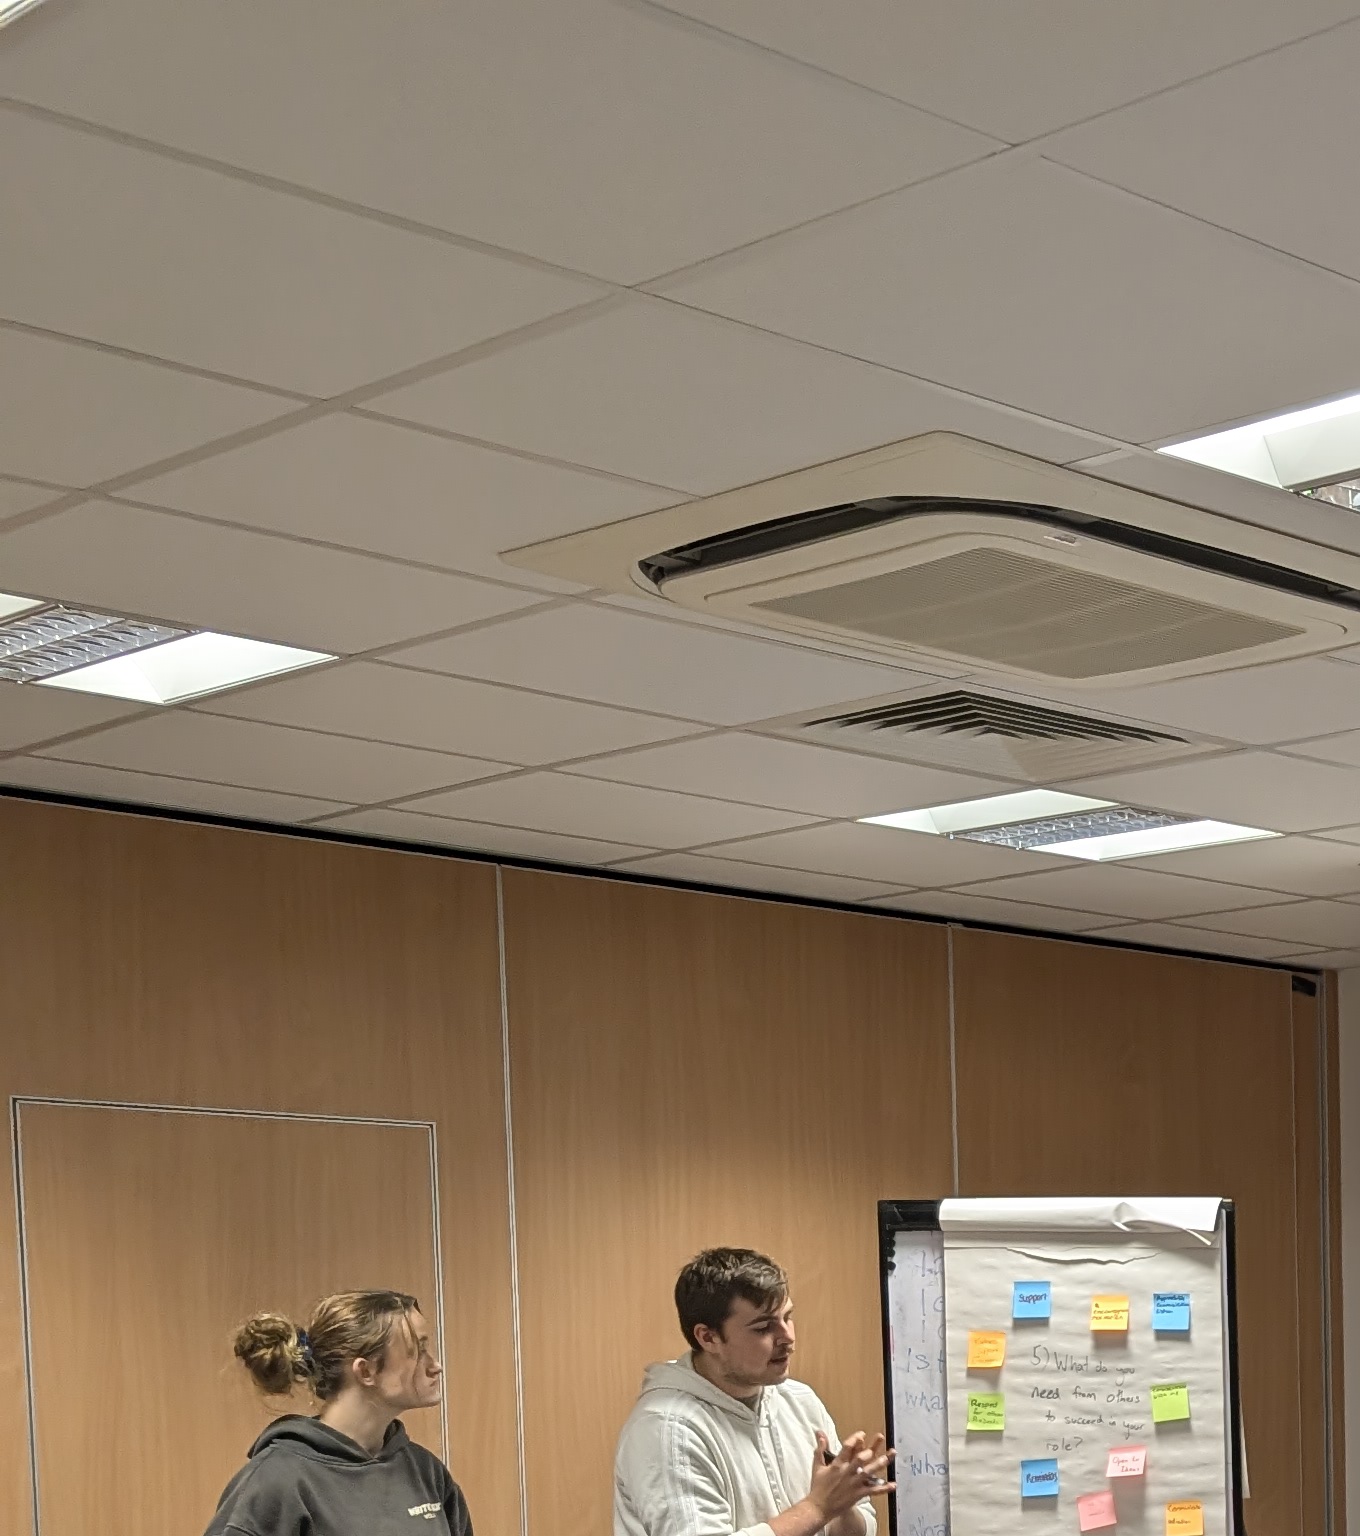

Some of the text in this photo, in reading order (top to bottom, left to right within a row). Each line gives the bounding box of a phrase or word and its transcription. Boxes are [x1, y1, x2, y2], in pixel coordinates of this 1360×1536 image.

[1018, 1293, 1047, 1304] Support
[1030, 1344, 1136, 1387] 5) What do you
[1072, 1385, 1097, 1401] from
[1045, 1409, 1146, 1441] to succeed in your
[1046, 1436, 1083, 1452] role?
